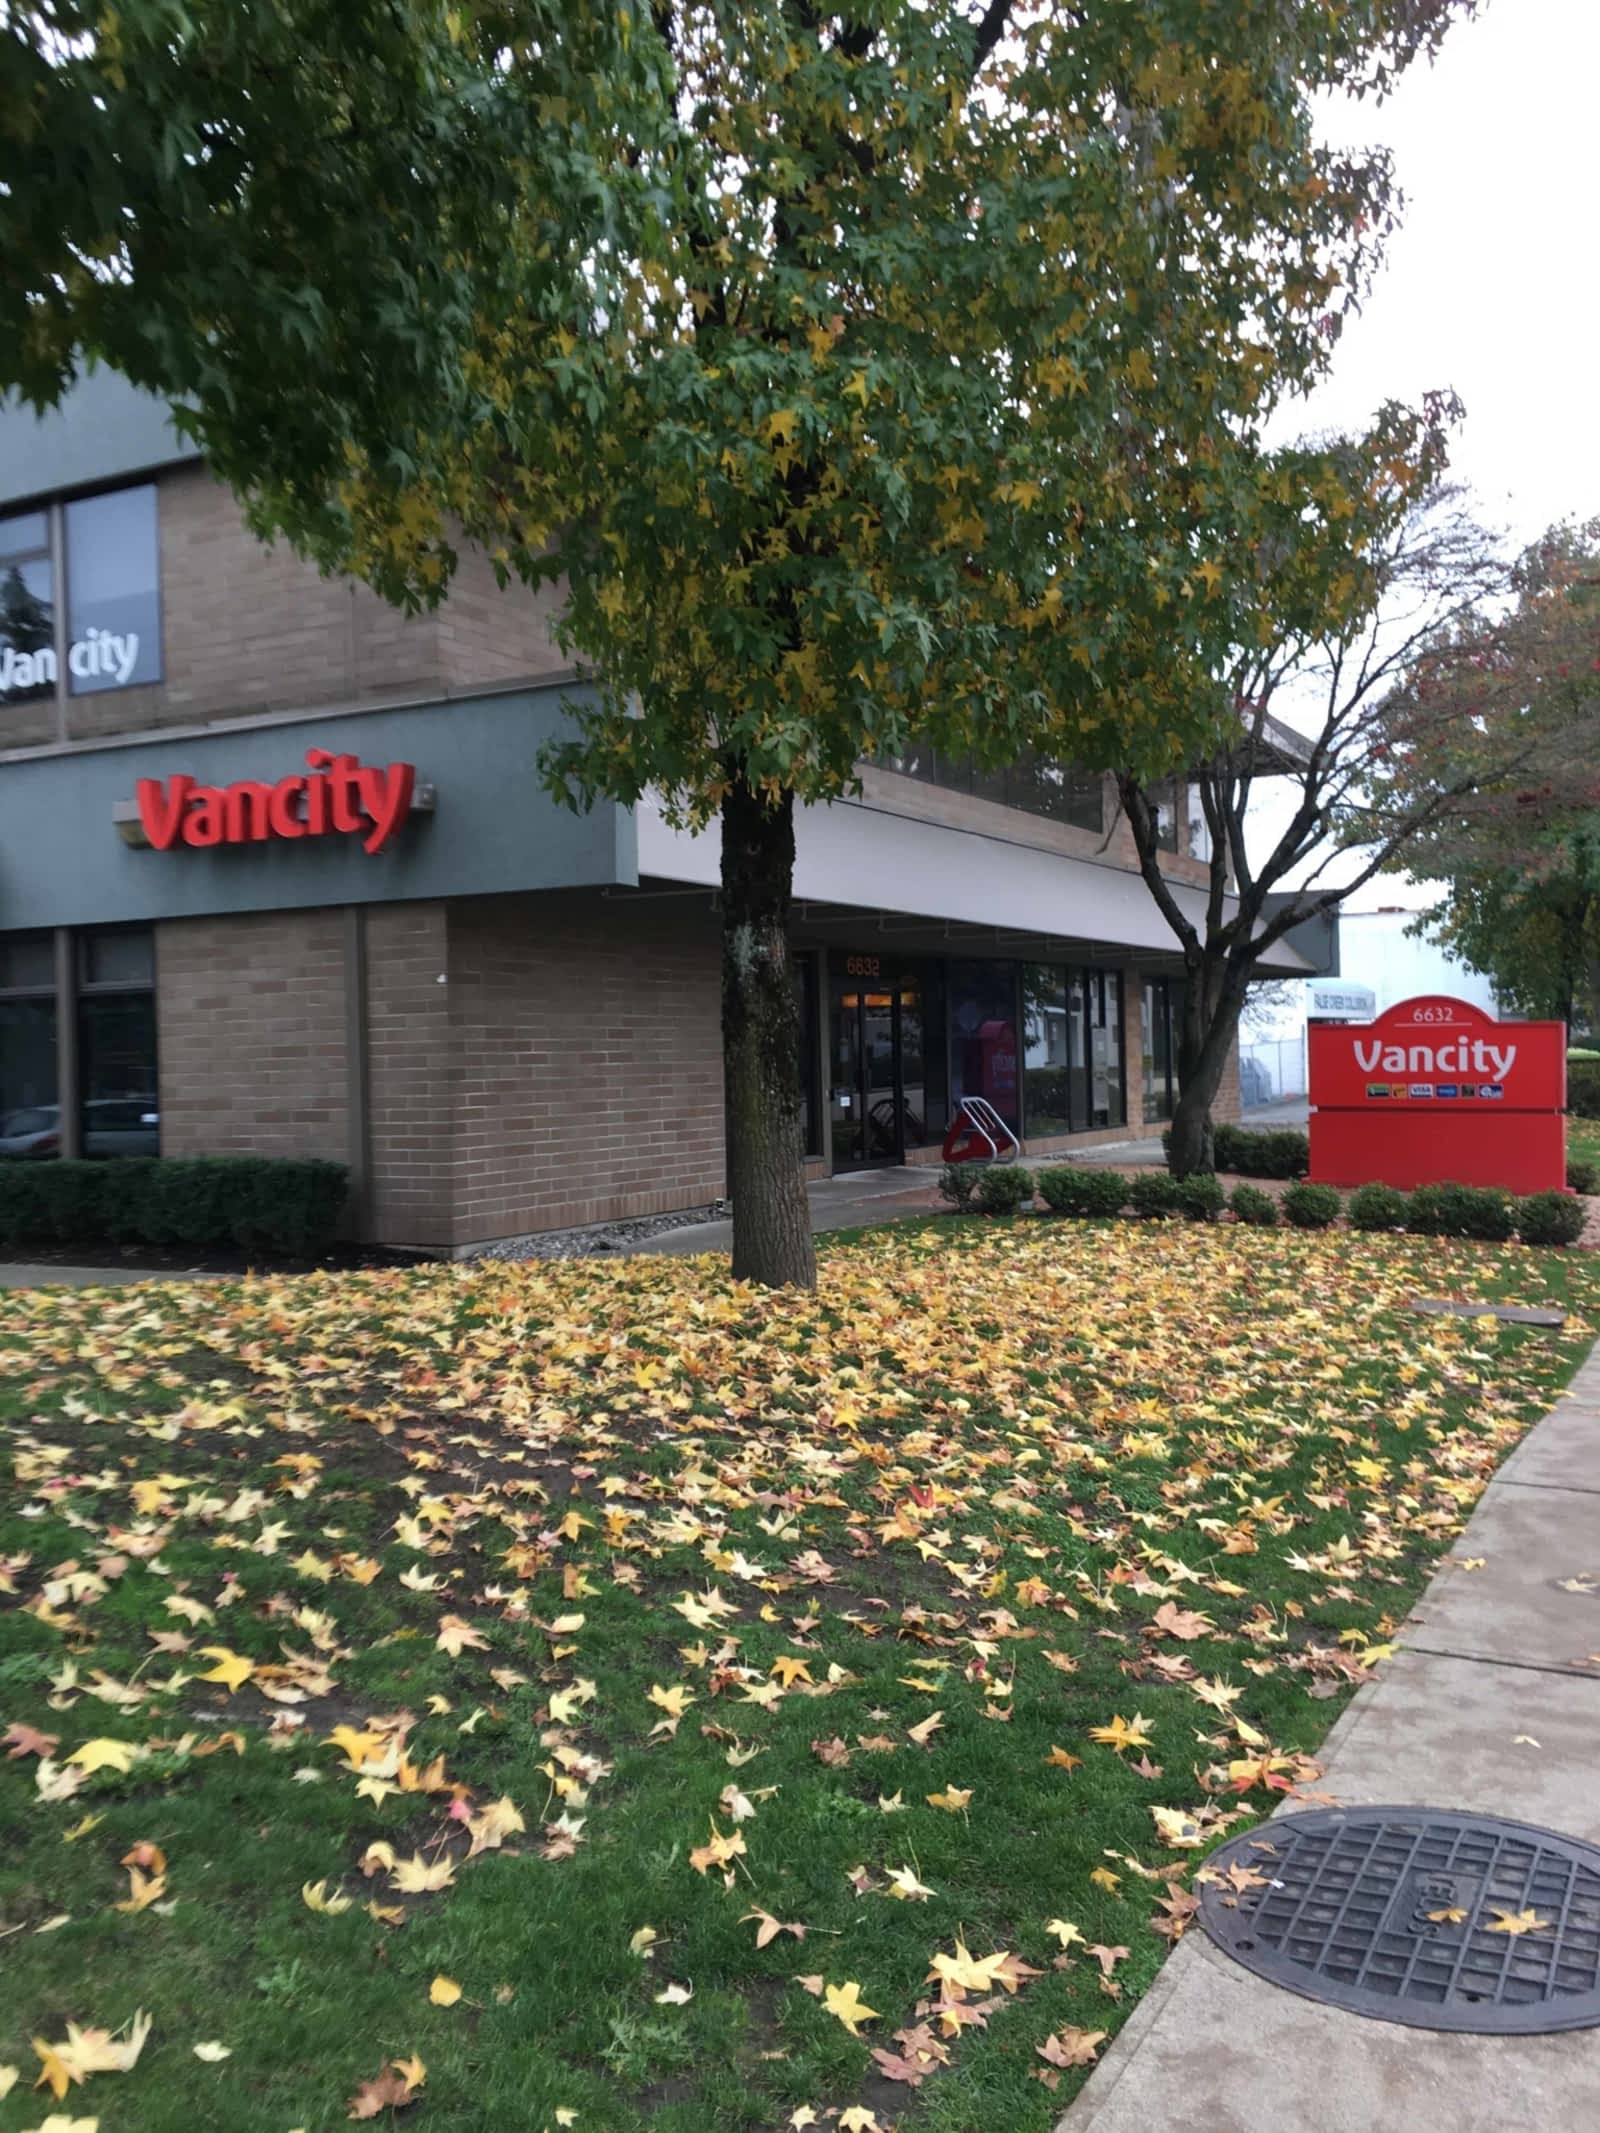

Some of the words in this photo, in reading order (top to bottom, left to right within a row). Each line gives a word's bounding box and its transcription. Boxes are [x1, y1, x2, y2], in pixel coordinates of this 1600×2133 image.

[137, 748, 415, 855] Vancity
[847, 957, 880, 977] 6632
[1413, 1008, 1454, 1022] 6632
[1353, 1035, 1516, 1081] Vancity
[1411, 1083, 1432, 1094] VISA
